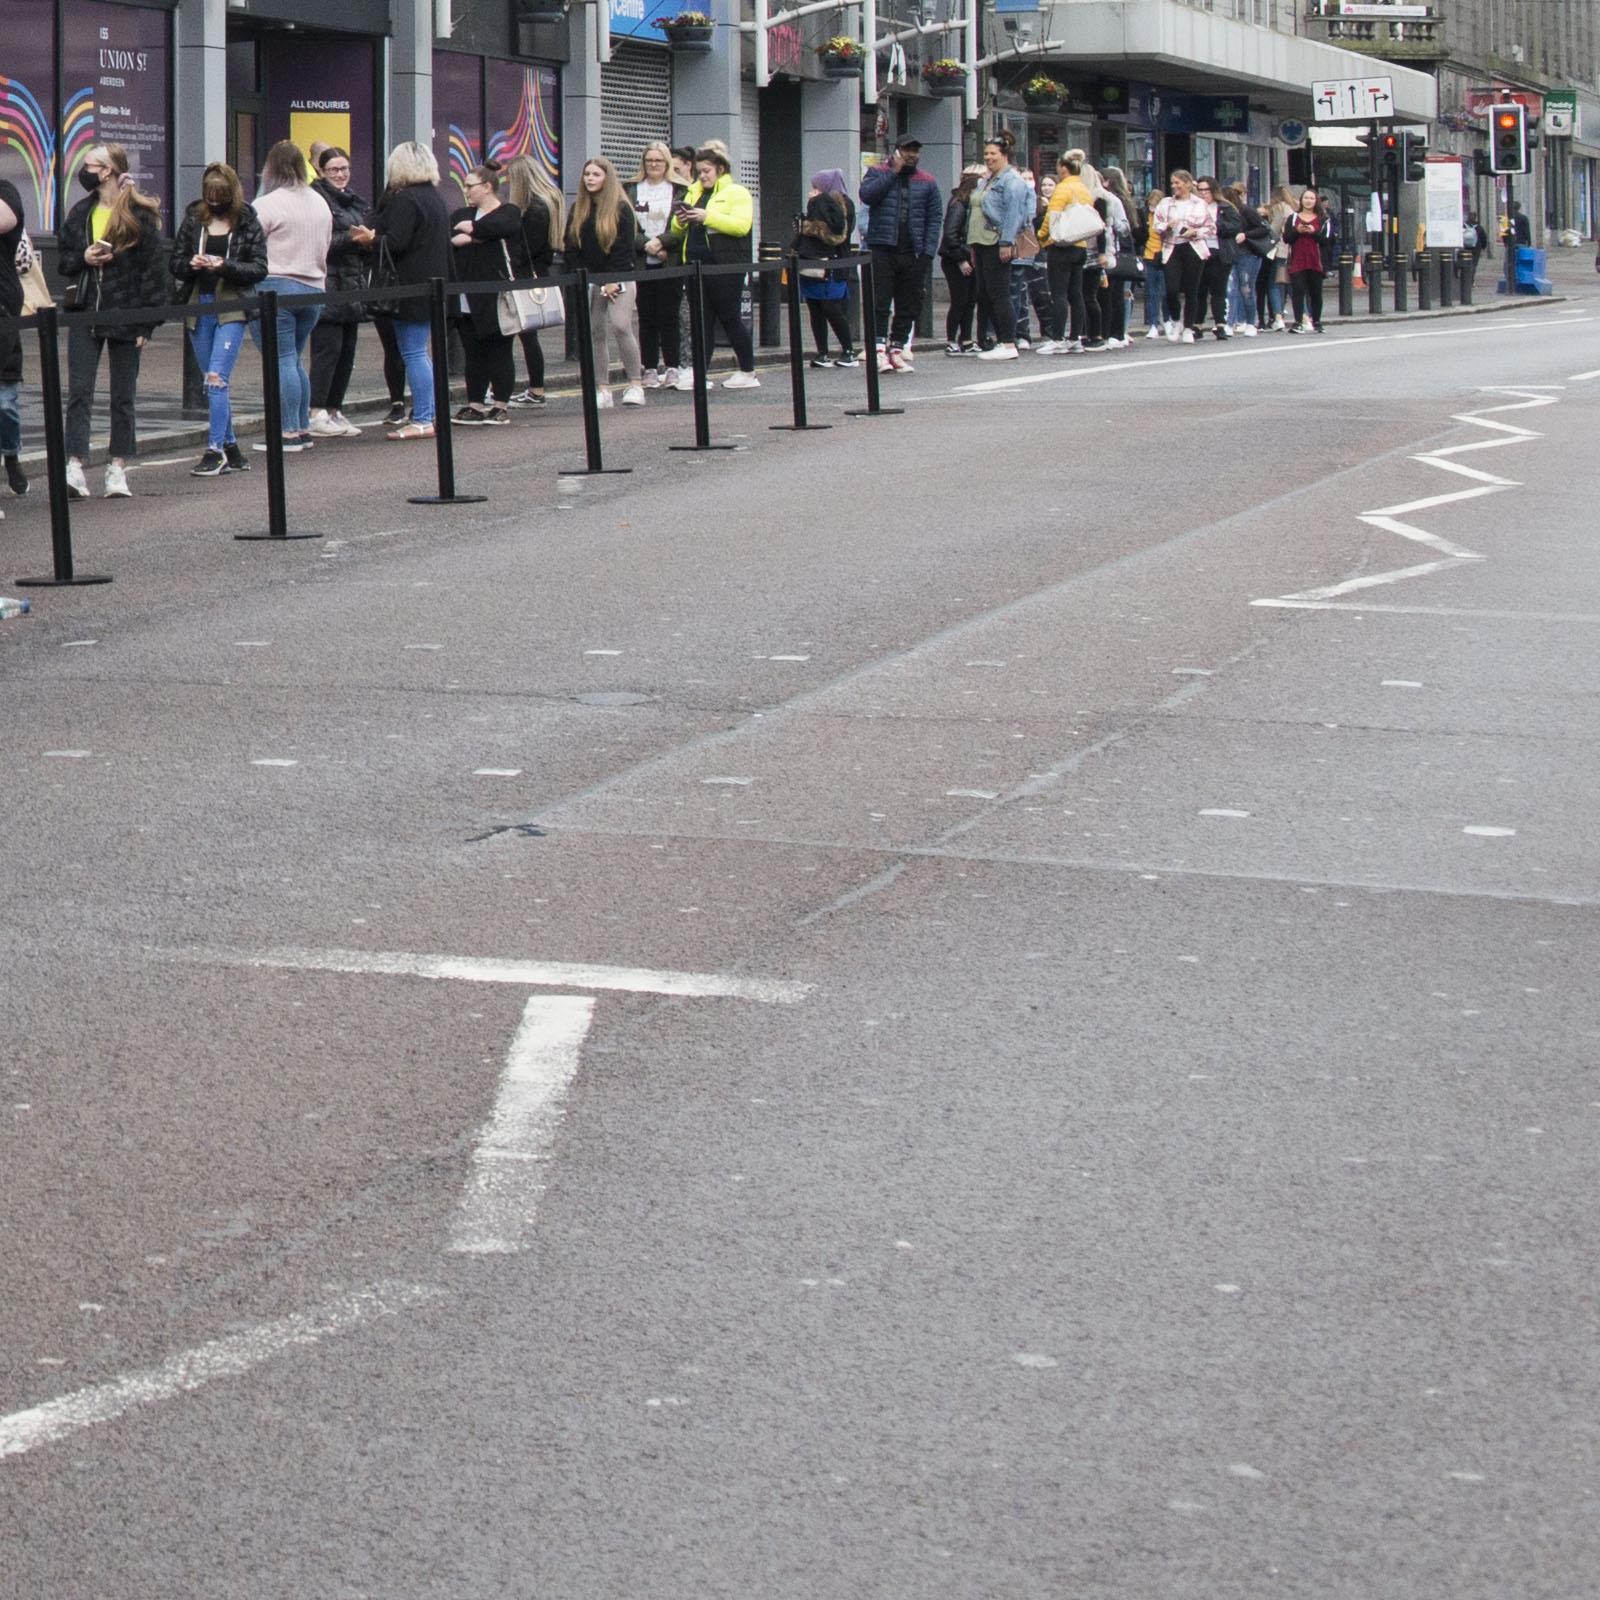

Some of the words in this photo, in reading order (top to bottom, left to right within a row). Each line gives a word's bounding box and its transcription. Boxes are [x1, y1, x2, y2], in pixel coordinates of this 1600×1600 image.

[100, 48, 135, 71] UNION
[290, 100, 305, 109] ALL
[307, 100, 350, 110] ENQUIRIES
